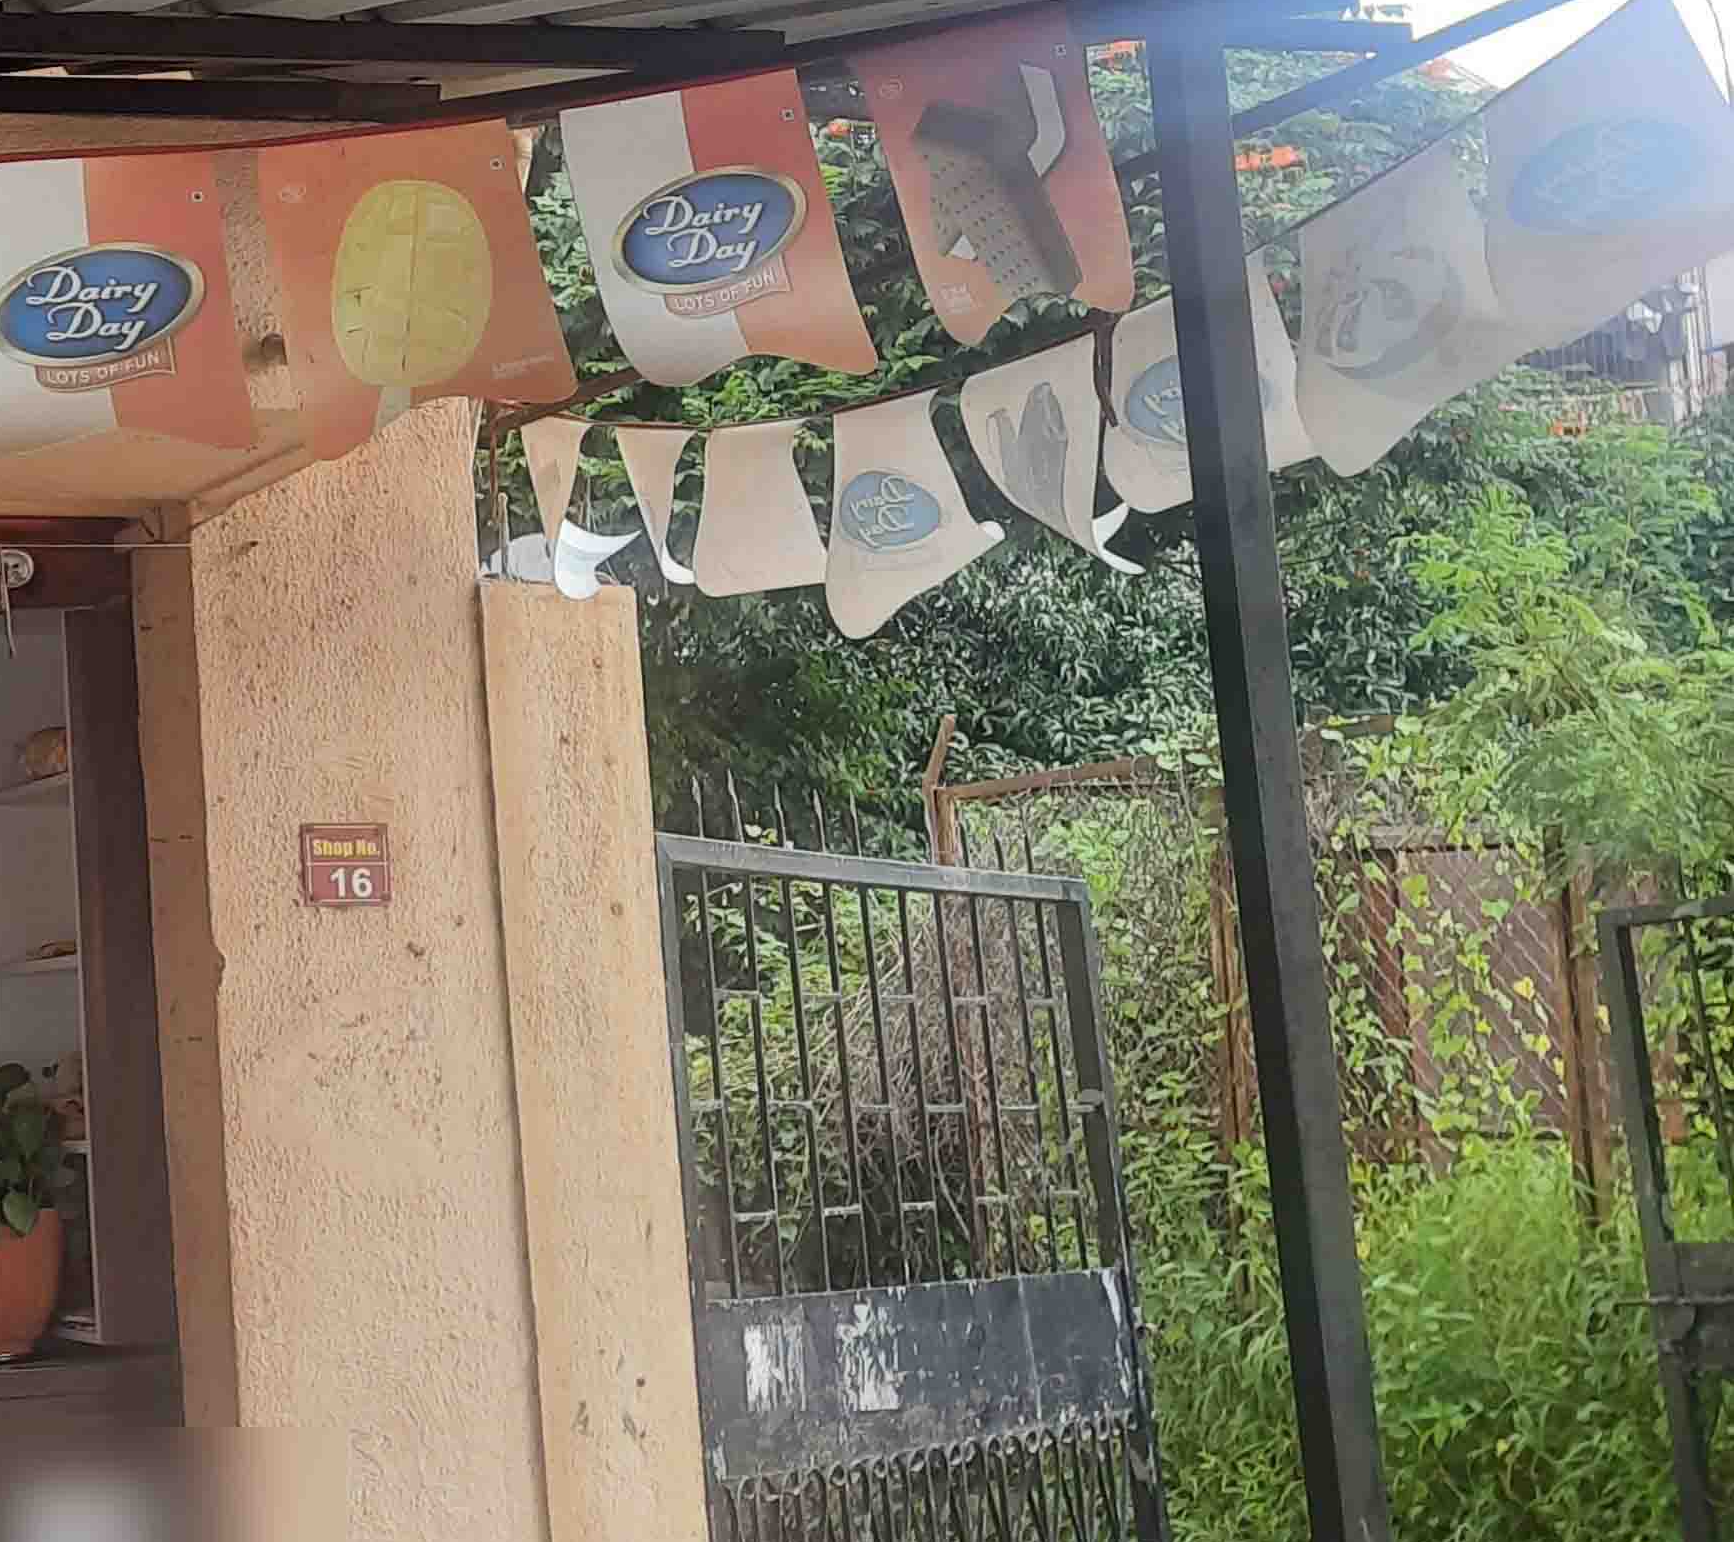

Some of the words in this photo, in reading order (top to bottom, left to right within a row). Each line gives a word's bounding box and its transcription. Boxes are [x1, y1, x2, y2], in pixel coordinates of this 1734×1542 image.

[640, 194, 764, 239] Dairy
[664, 228, 758, 272] Day
[24, 265, 161, 315] Dairy
[673, 291, 716, 313] LOTS
[719, 285, 742, 306] OF
[744, 271, 777, 300] FUN
[44, 302, 148, 351] Day
[45, 366, 91, 386] LOTS
[95, 362, 120, 380] OF
[124, 351, 161, 375] FUN
[312, 838, 355, 858] Shop
[329, 867, 373, 899] 16
